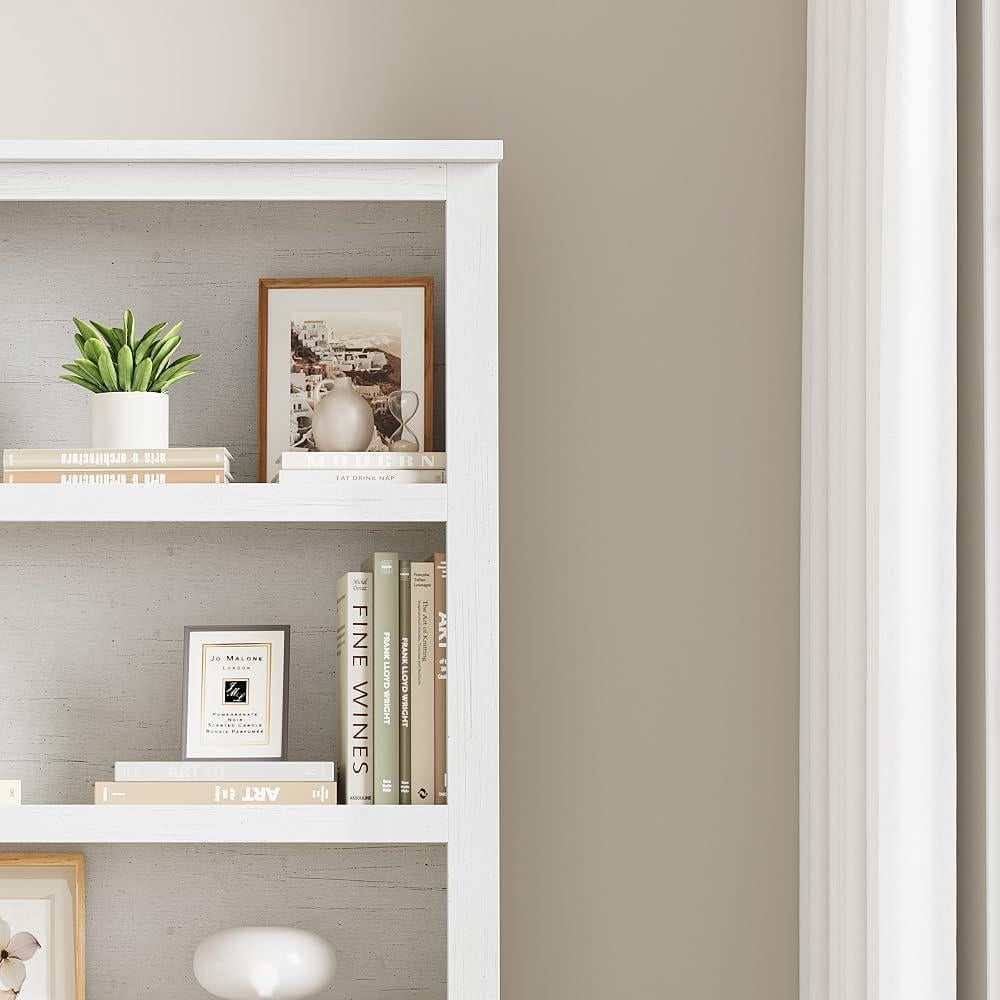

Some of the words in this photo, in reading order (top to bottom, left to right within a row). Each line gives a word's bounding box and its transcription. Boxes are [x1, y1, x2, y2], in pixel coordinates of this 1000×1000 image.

[352, 606, 368, 666] FINE
[352, 681, 368, 774] WINES
[242, 787, 280, 801] ART
